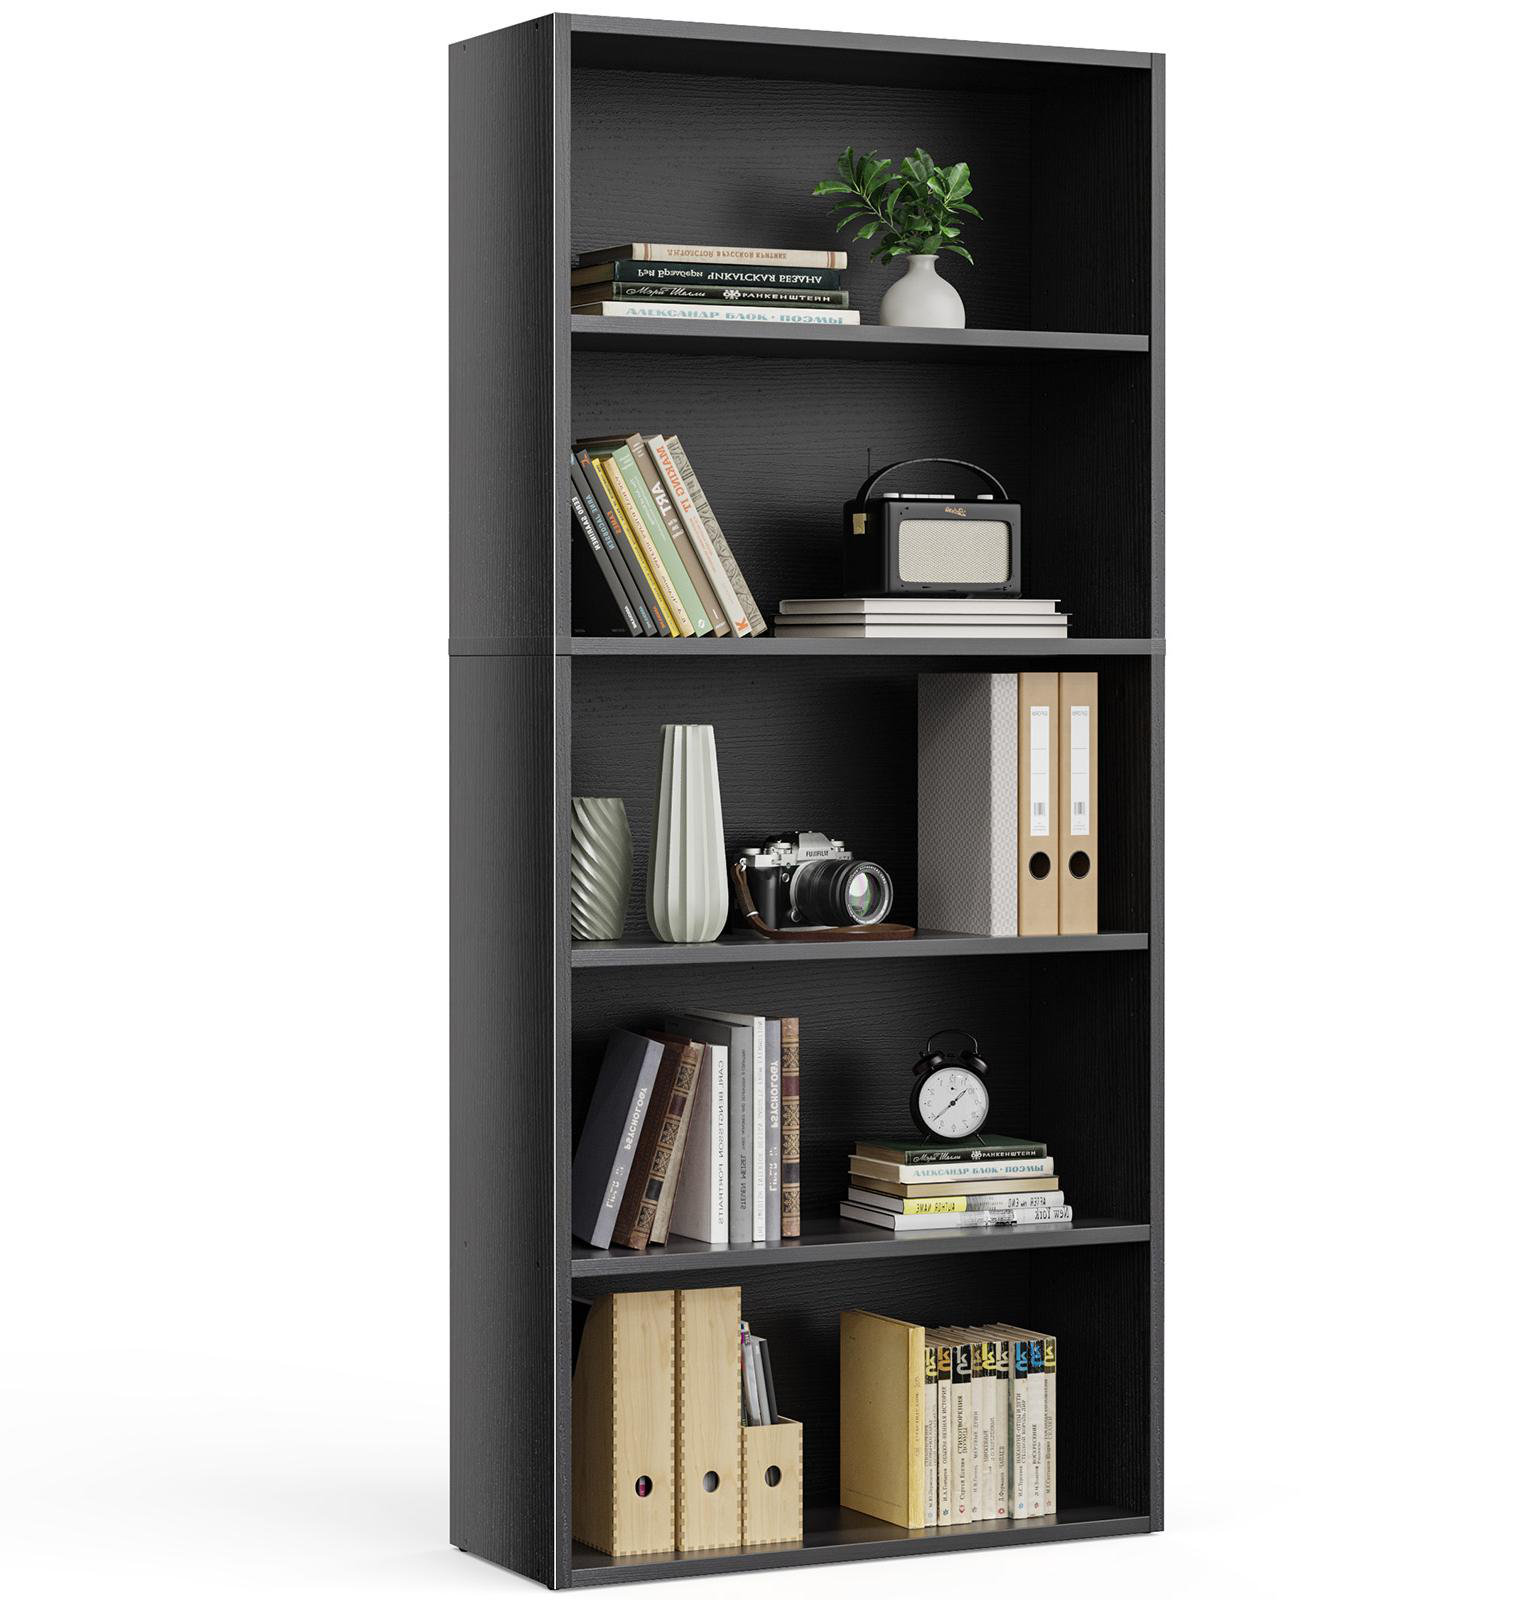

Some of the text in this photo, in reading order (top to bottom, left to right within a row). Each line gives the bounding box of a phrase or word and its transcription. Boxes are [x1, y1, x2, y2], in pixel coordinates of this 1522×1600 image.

[625, 307, 843, 325] АЛЕКСАНДР БЛОК ПОЭМЫ
[912, 1168, 969, 1177] АЛЕКСАНДР
[1005, 1164, 1044, 1173] ПОЭМЫ
